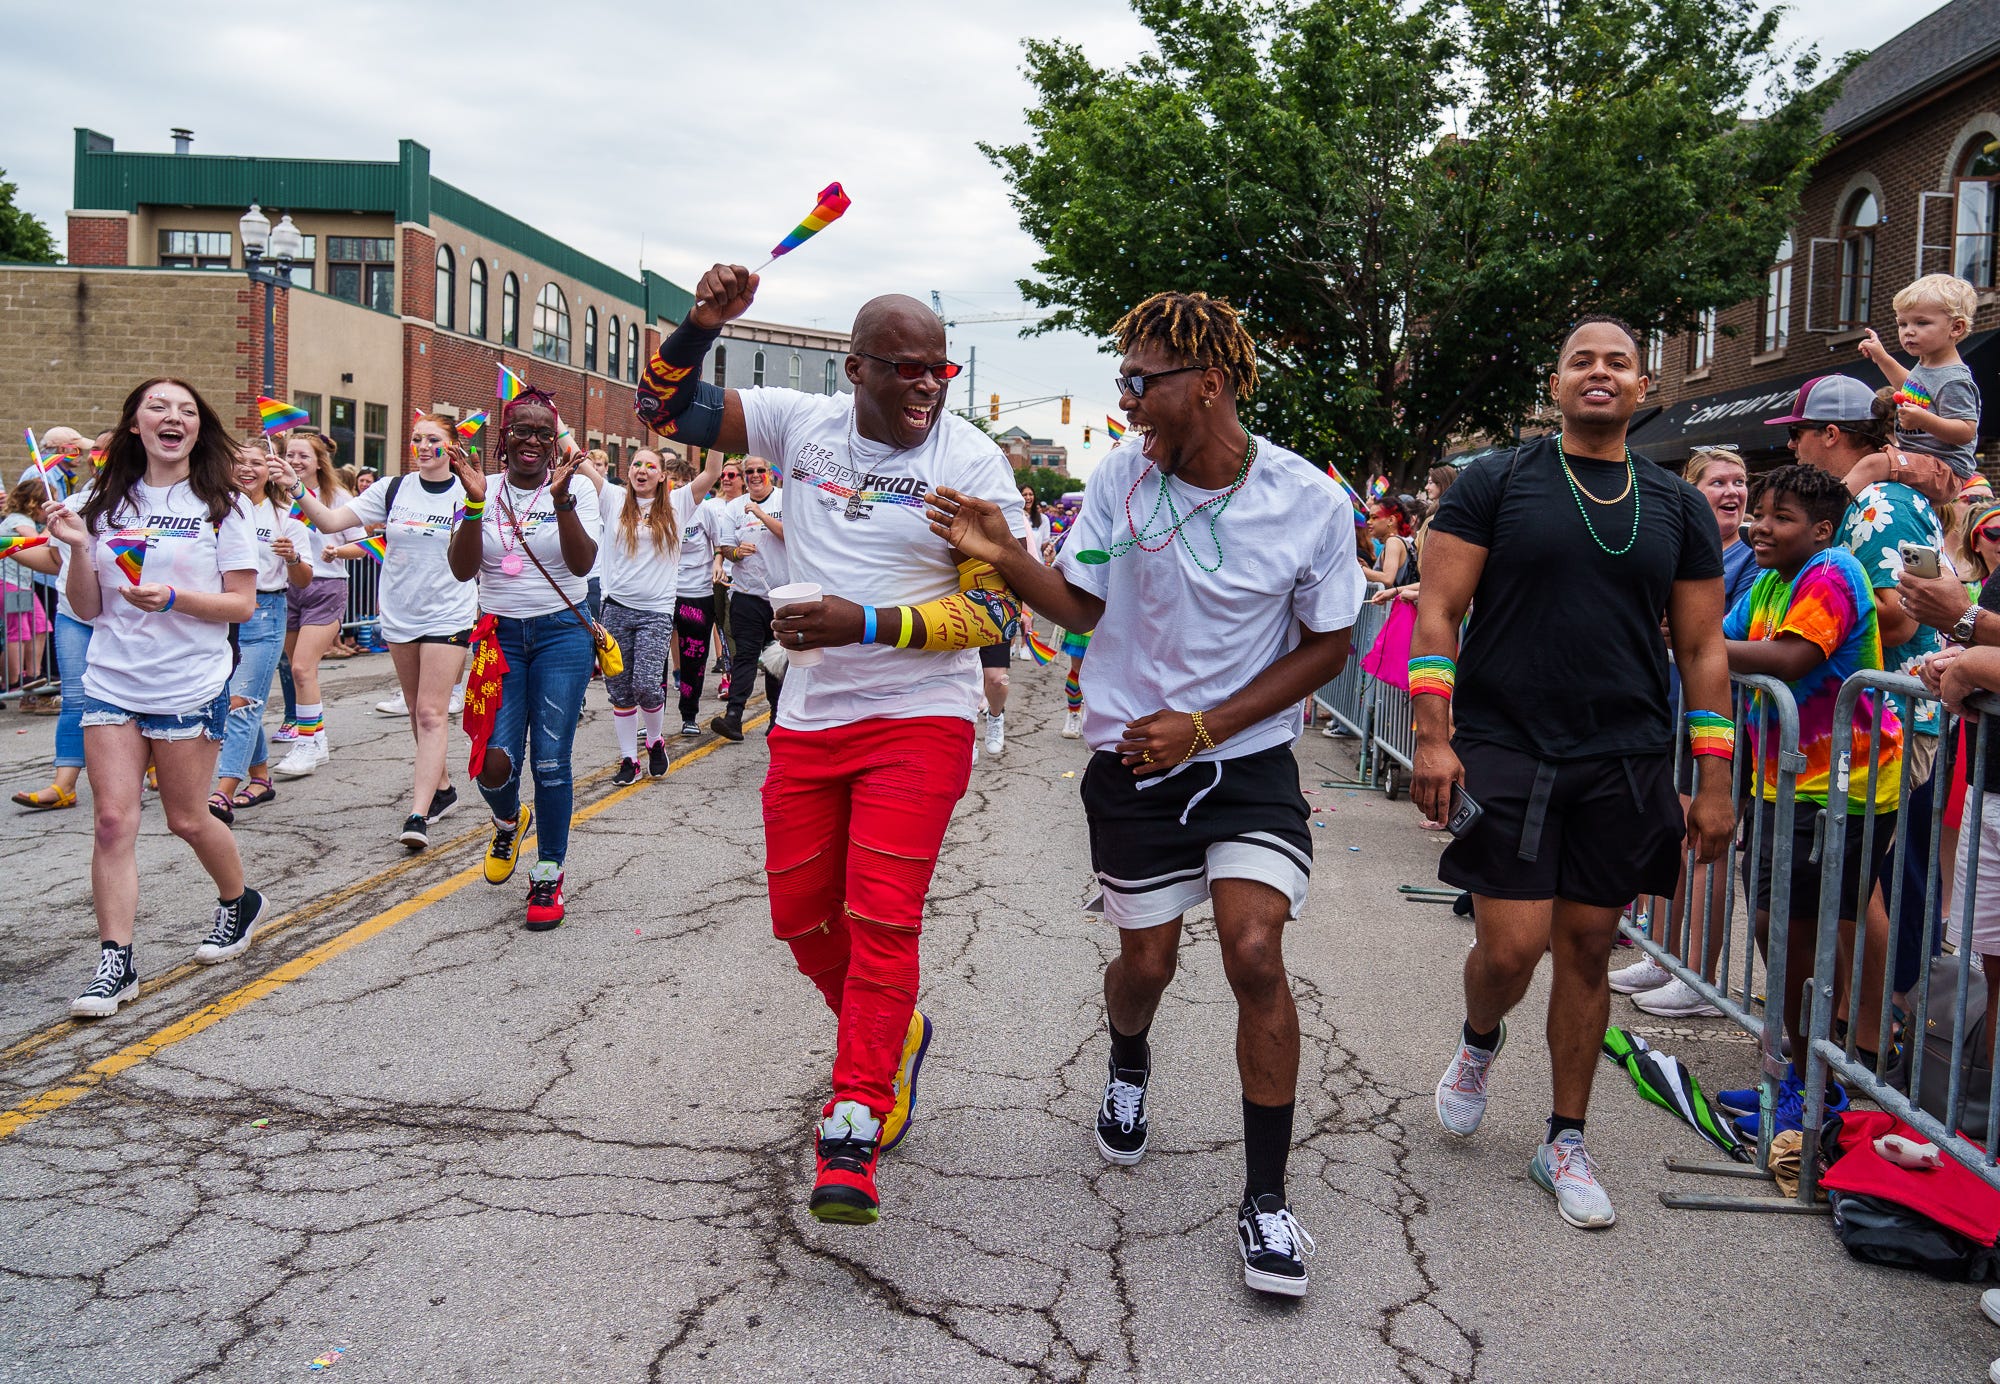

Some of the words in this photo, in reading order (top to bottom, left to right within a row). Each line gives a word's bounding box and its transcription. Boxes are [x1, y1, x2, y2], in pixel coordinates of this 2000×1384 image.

[1683, 391, 1789, 425] CENTURY
[802, 442, 834, 460] 2022
[794, 449, 867, 490] HAPPY
[860, 473, 929, 499] PRIDE
[147, 515, 202, 531] PRIDE
[426, 514, 454, 526] PRID
